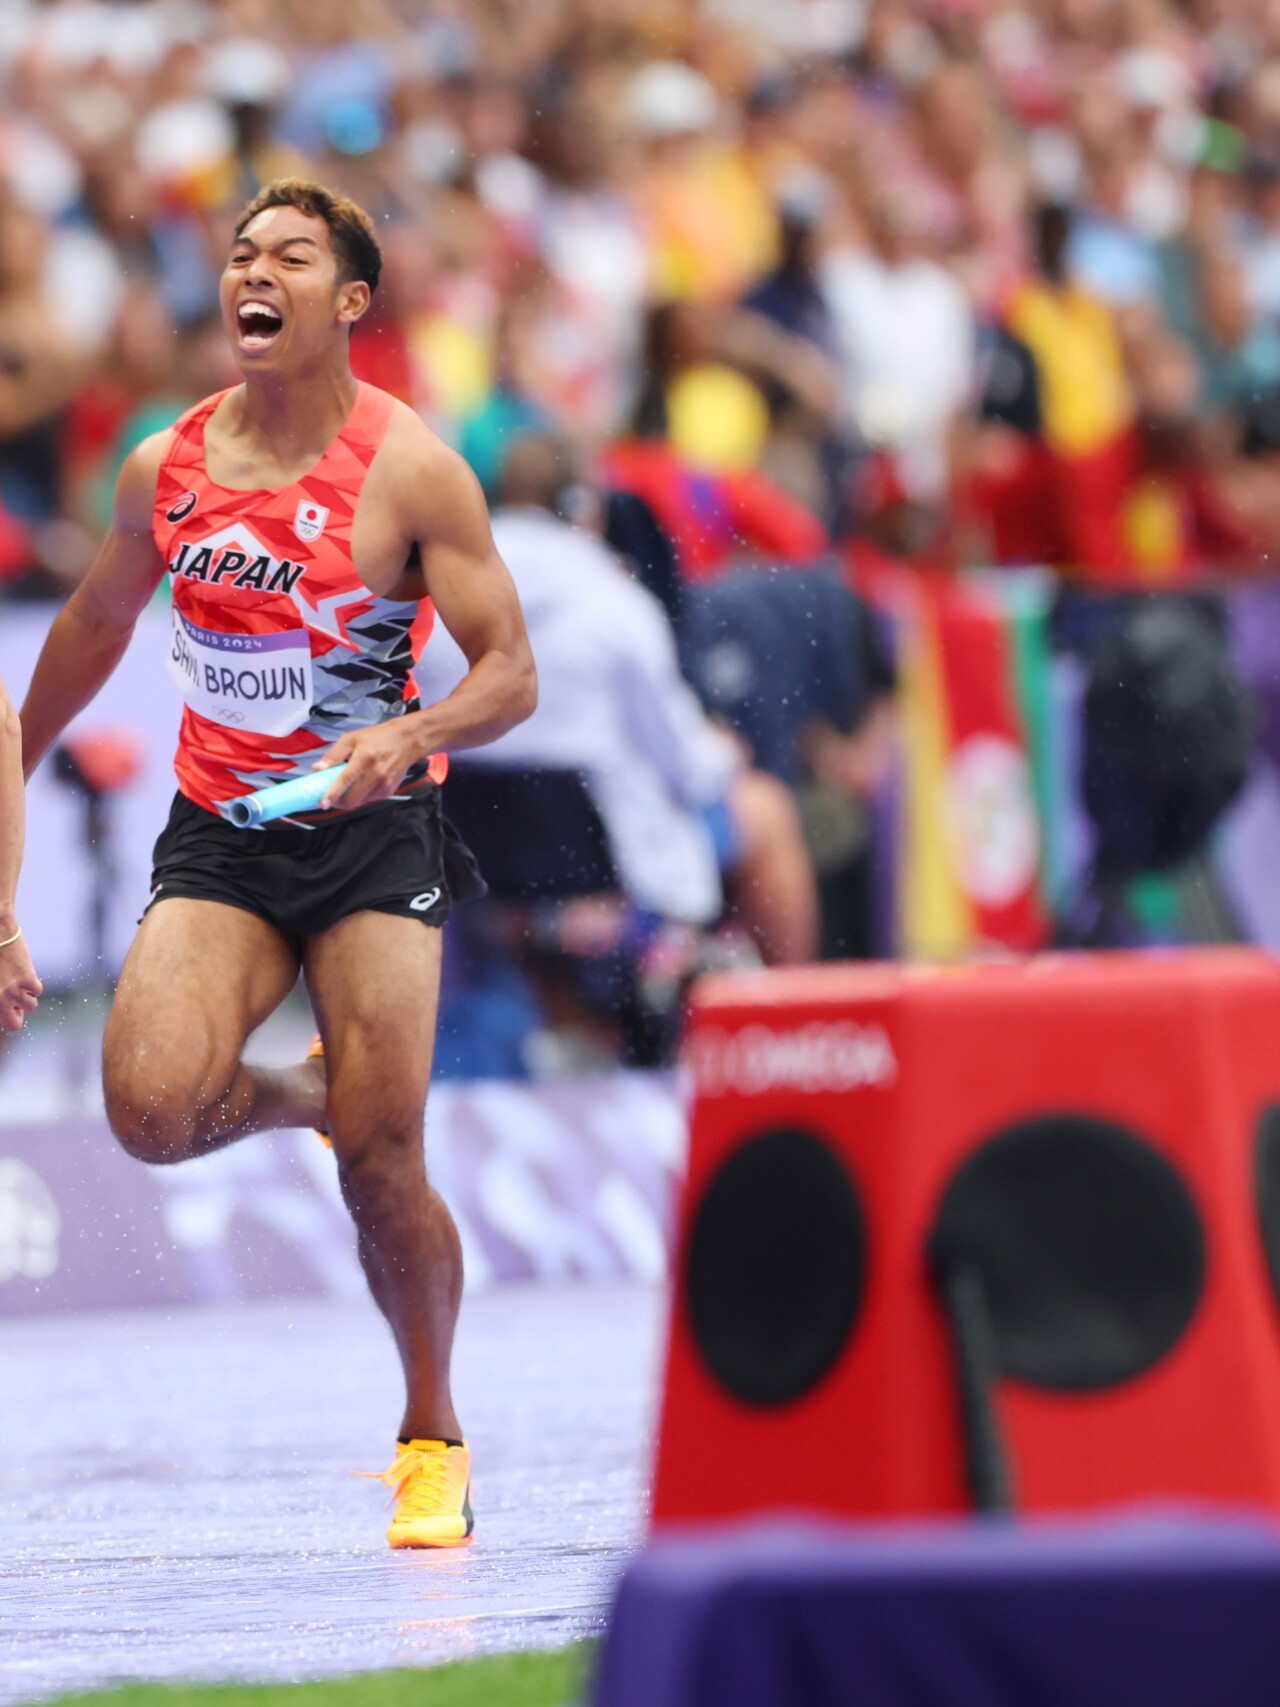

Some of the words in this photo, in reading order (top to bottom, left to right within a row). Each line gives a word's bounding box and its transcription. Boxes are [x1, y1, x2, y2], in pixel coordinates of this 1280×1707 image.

[169, 544, 305, 594] JAPAN
[185, 622, 219, 645] PARIS
[222, 637, 262, 649] 2024
[204, 663, 306, 701] BROWN
